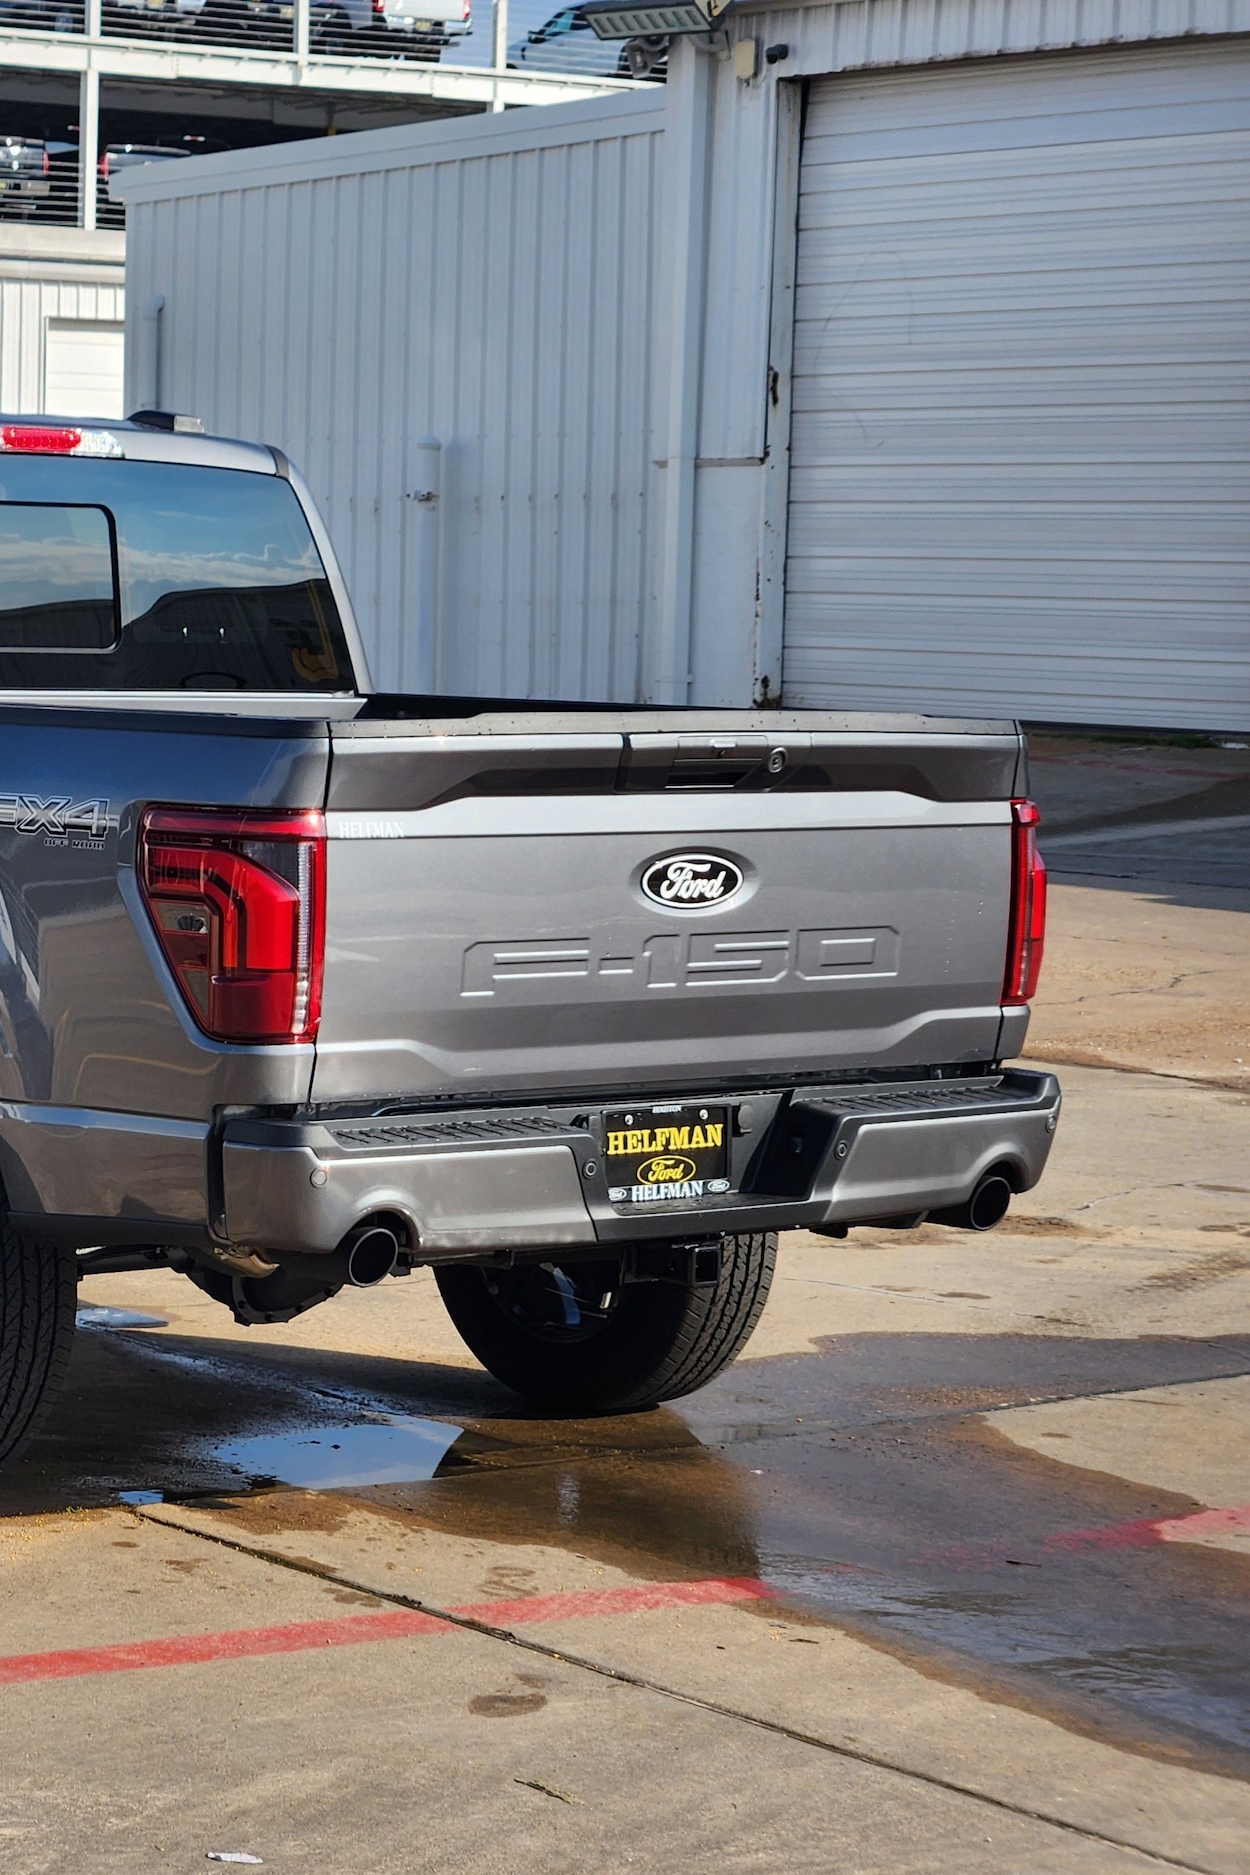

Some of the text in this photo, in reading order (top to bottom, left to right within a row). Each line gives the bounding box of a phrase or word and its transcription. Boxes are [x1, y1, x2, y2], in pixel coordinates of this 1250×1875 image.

[339, 821, 405, 838] HELFMAN
[659, 861, 727, 899] Ford
[460, 925, 900, 998] F-150
[607, 1123, 724, 1155] HELFMAN
[648, 1159, 685, 1182] Ford
[631, 1180, 704, 1201] HELFMAN
